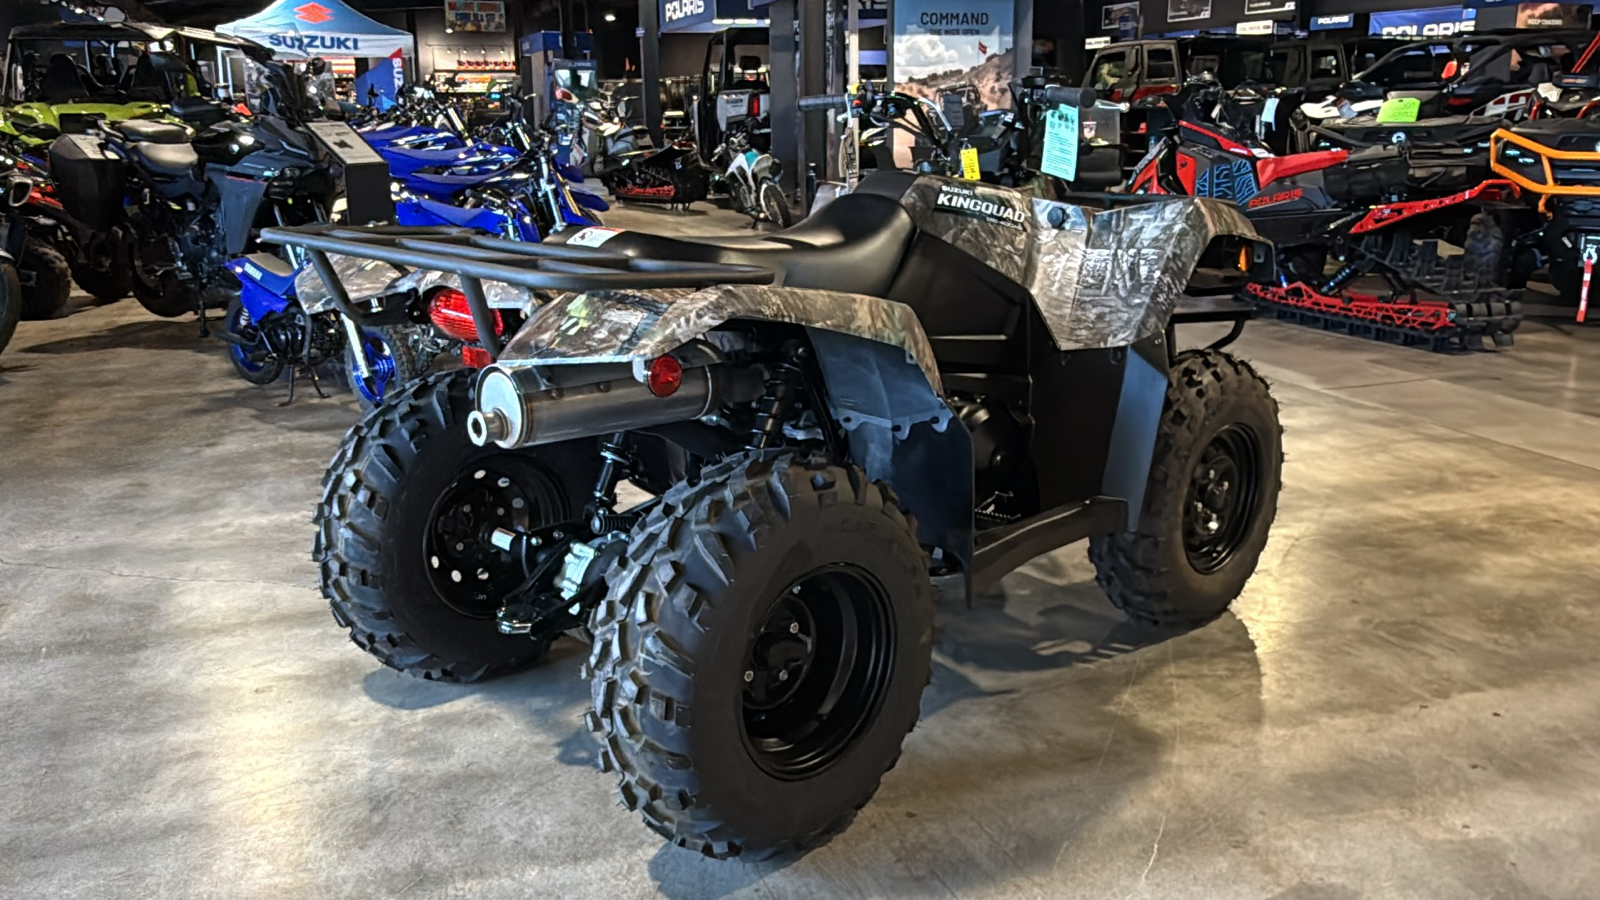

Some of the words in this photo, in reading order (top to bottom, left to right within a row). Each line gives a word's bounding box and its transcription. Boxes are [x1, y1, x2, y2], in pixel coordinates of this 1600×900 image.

[665, 0, 705, 22] POLARIS
[920, 12, 989, 25] COMMAND
[1318, 15, 1349, 24] POLARIS
[268, 34, 359, 50] SUZUKI
[941, 185, 973, 195] SUZUKI
[1248, 188, 1303, 208] POLARIS
[937, 193, 1025, 222] KINGQUAD
